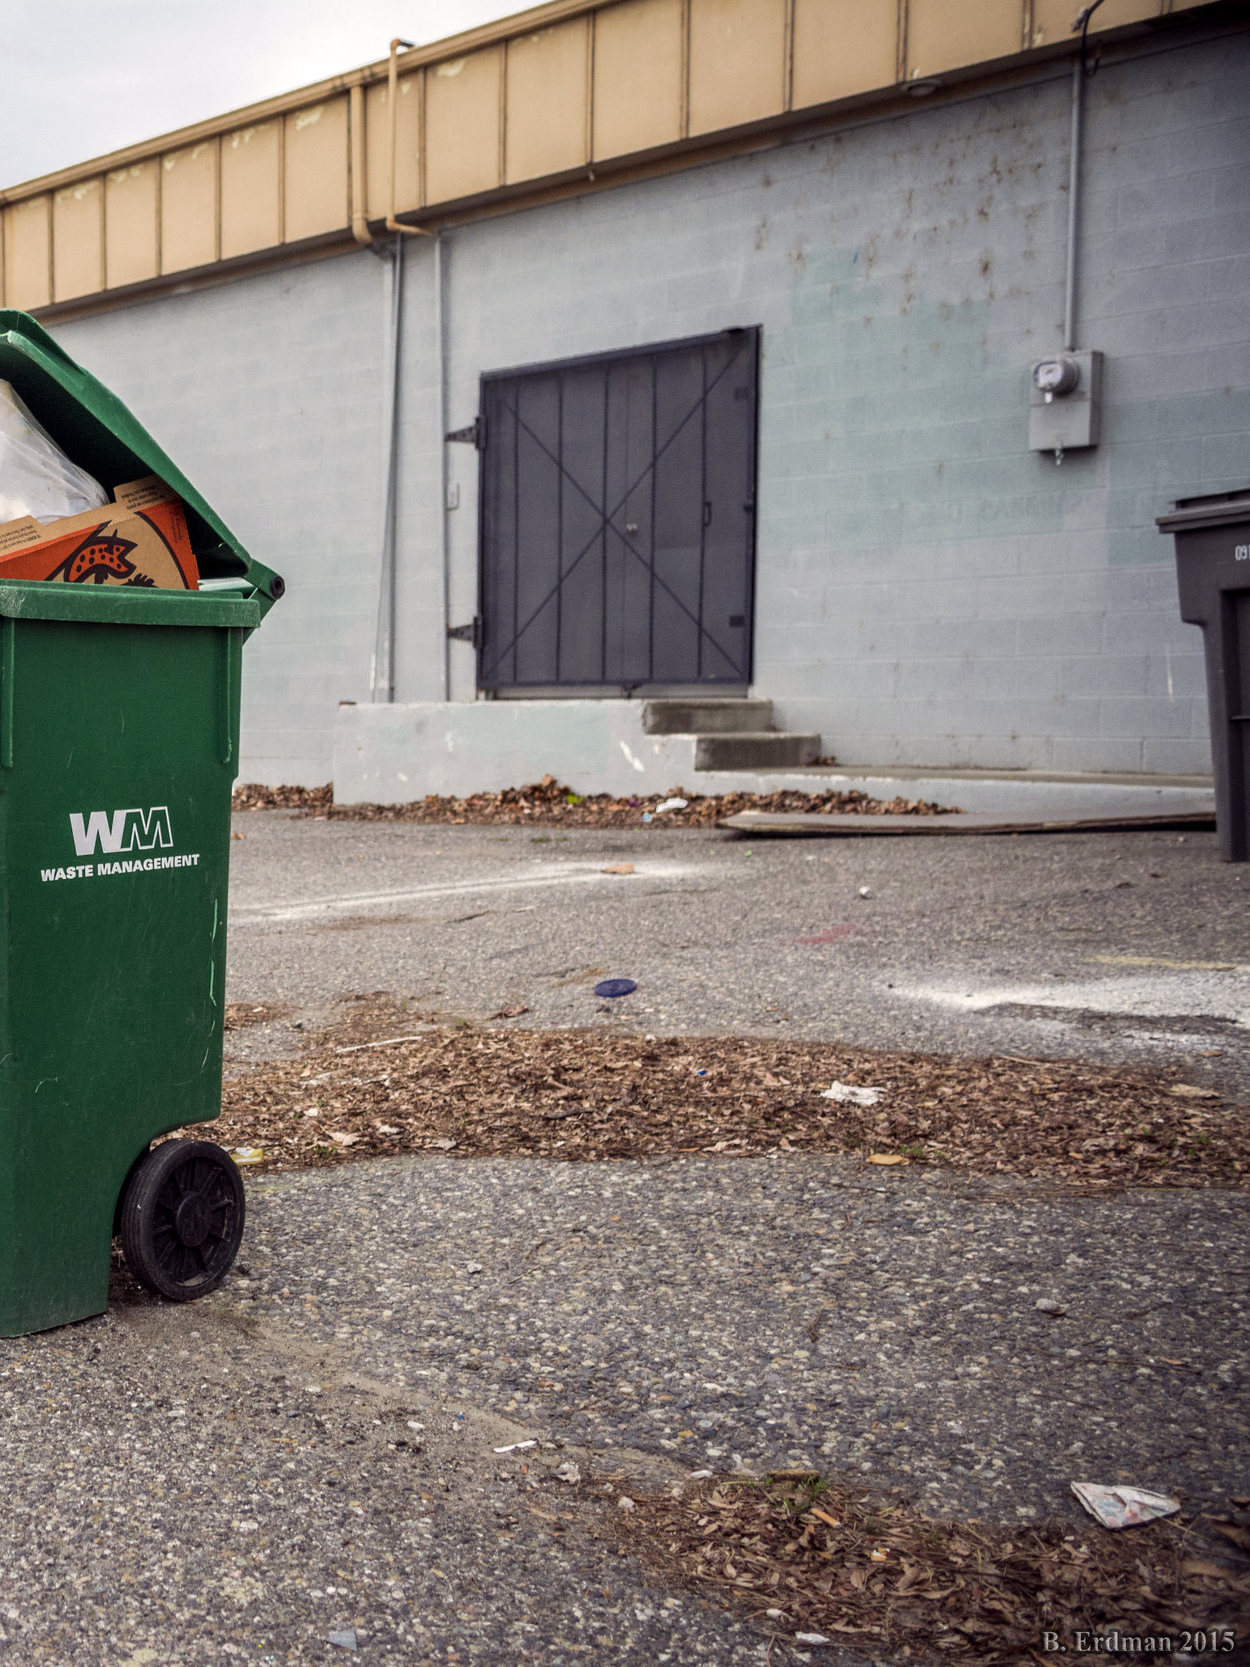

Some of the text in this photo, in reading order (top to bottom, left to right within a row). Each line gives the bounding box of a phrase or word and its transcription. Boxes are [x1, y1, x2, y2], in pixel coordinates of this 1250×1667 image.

[69, 806, 173, 856] WM
[40, 854, 200, 882] WASTE MANAGEMENT
